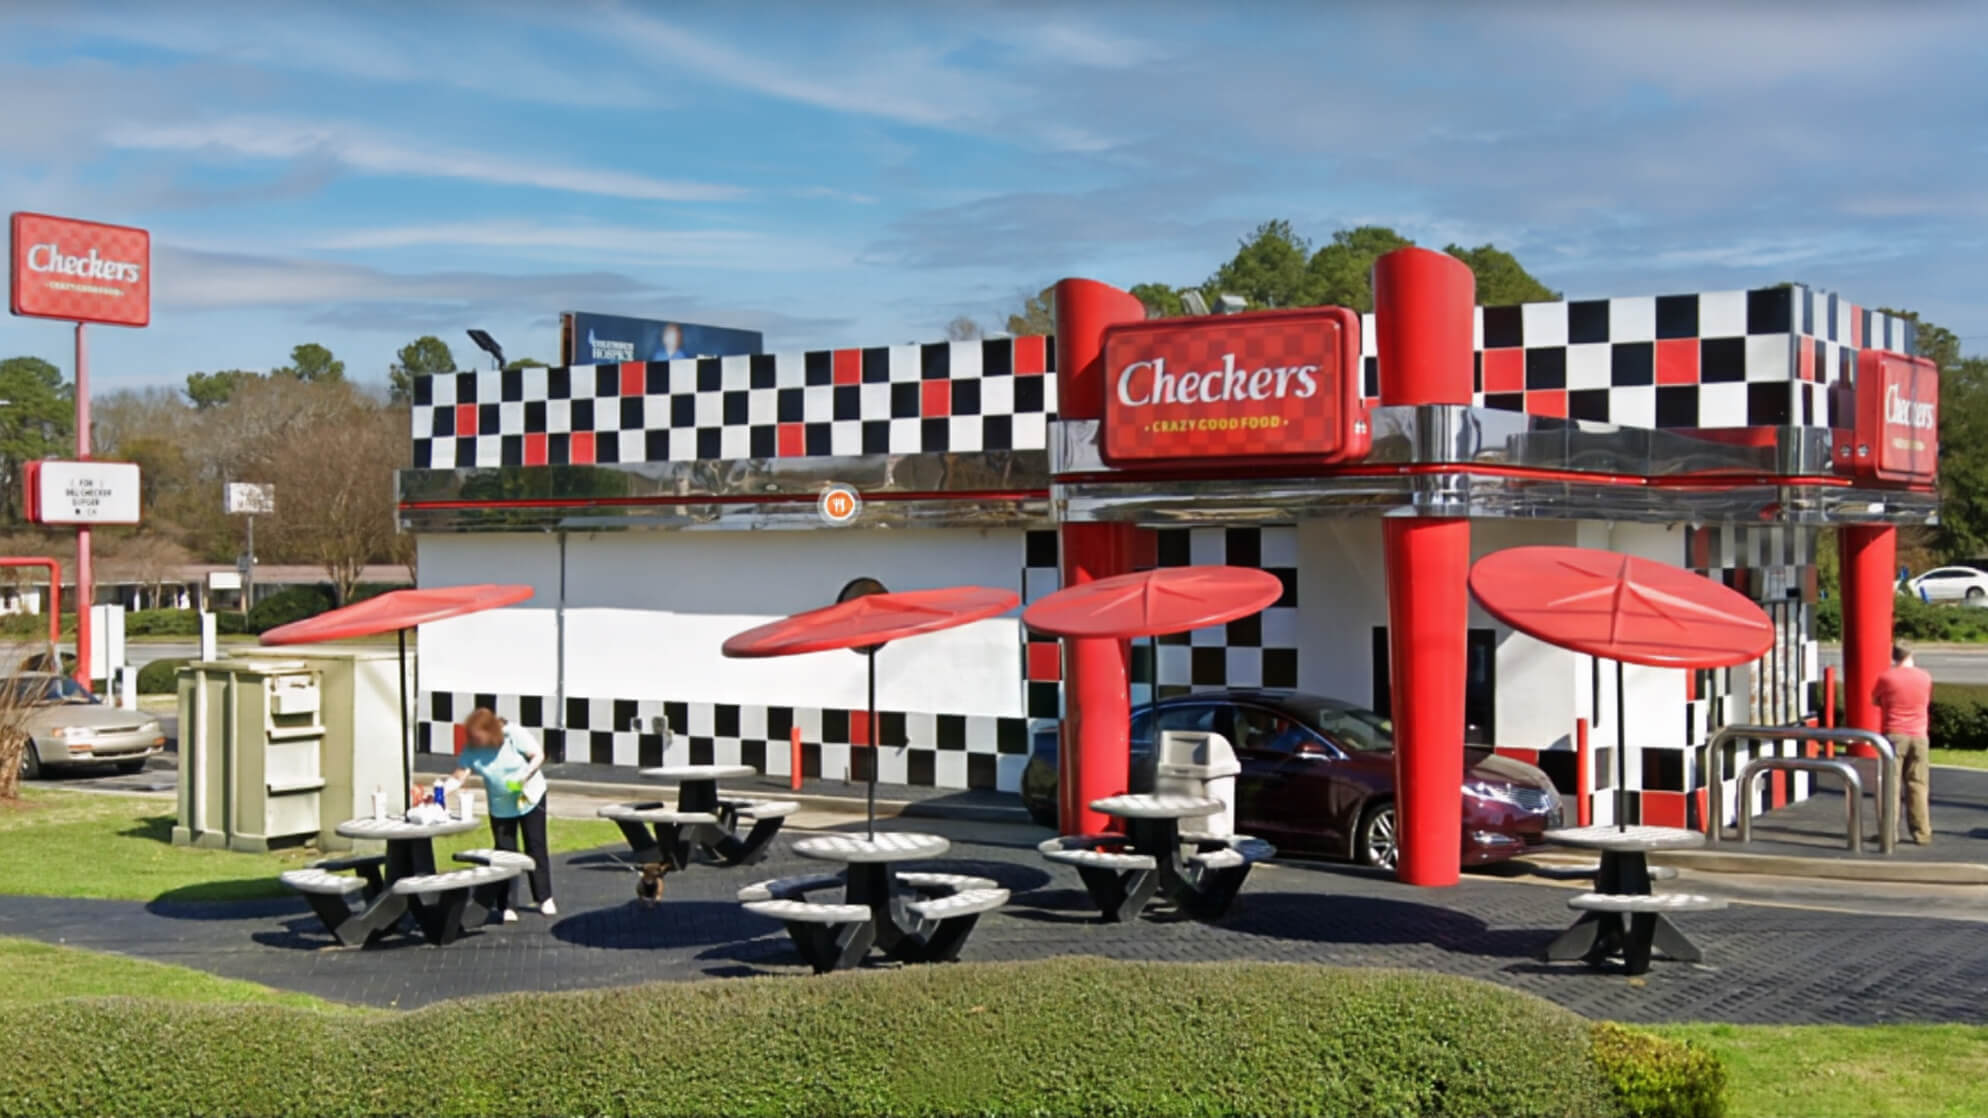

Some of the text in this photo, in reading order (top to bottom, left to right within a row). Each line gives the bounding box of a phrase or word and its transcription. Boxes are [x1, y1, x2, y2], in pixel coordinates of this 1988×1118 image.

[27, 243, 140, 283] Checkers
[1117, 353, 1320, 407] Checkers
[1152, 415, 1280, 433] CRAZY GOOD FOOD
